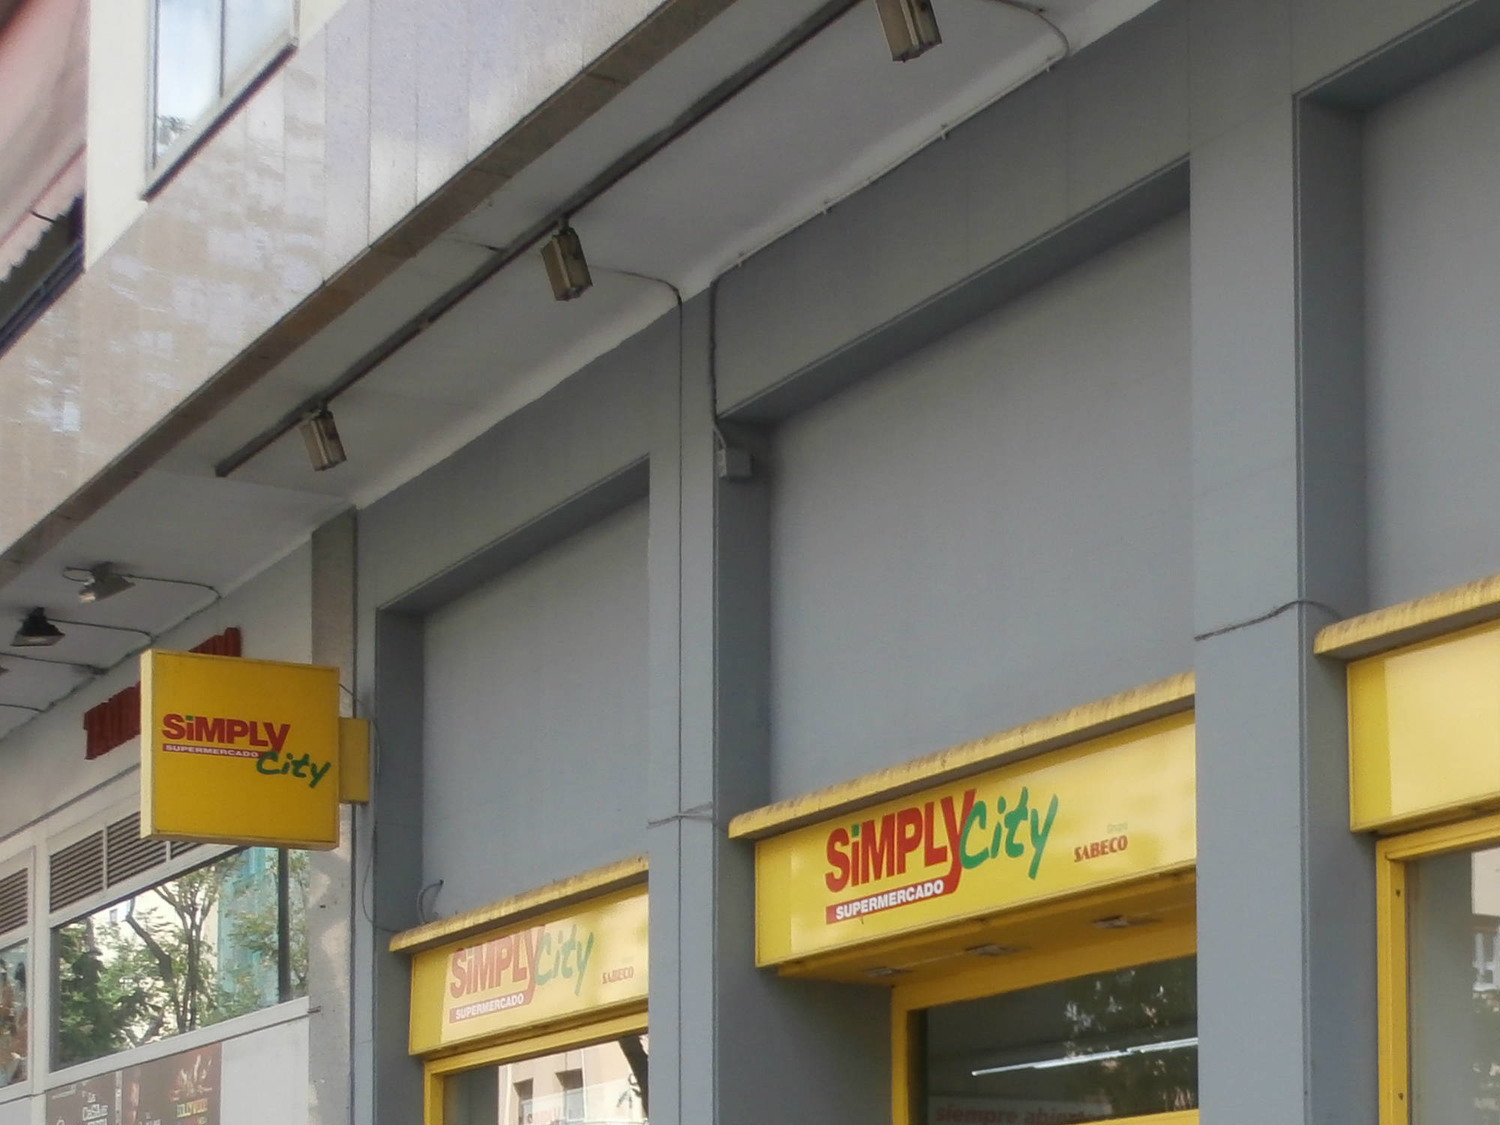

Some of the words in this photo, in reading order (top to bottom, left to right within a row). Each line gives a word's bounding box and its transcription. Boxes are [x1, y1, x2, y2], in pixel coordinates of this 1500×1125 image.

[165, 744, 259, 758] SUPERMERCADO
[256, 751, 331, 788] City
[959, 787, 1059, 880] City
[1074, 835, 1128, 863] SABECO
[836, 880, 944, 920] SUPERMERCADO
[535, 924, 594, 996] City
[455, 993, 525, 1020] SUPERMERCADO
